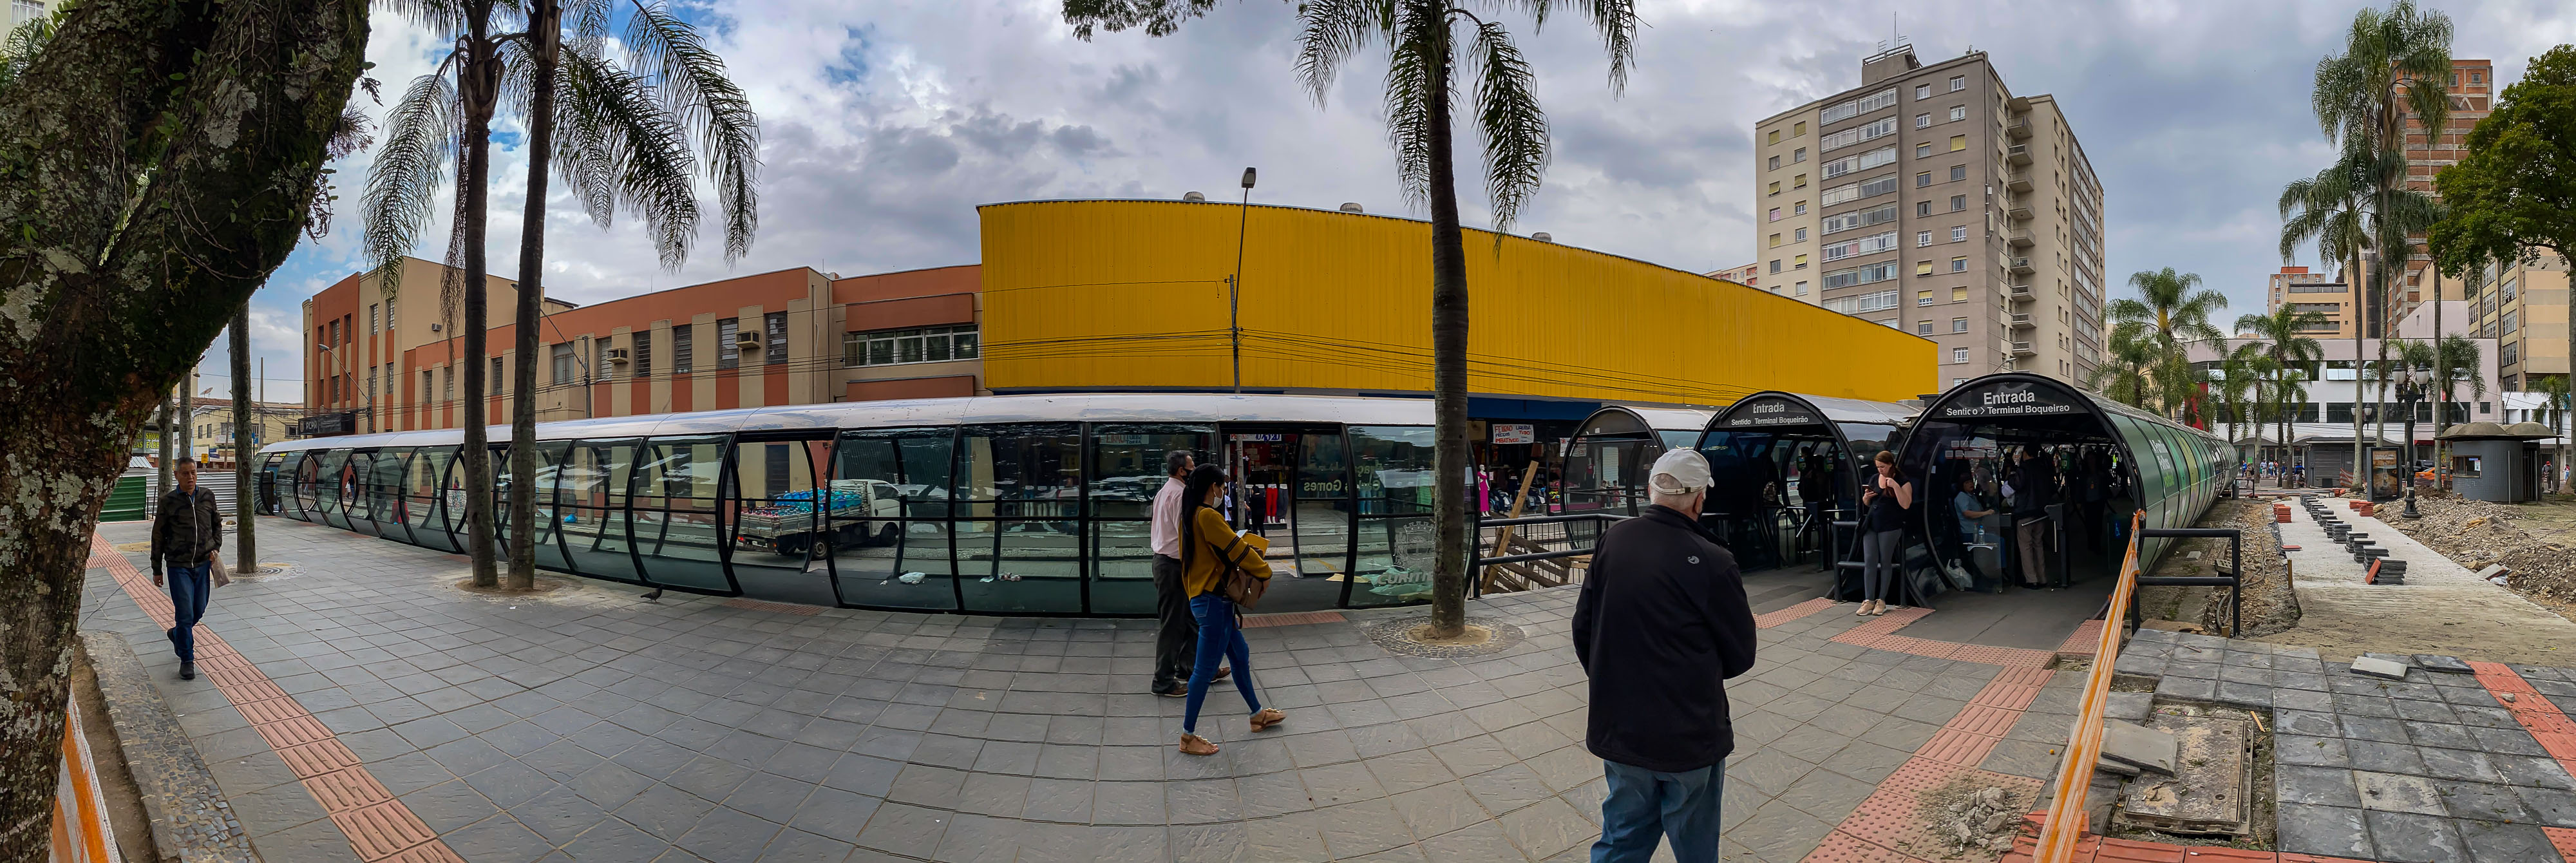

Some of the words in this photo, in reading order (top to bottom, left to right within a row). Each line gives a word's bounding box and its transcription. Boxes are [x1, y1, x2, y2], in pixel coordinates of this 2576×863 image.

[1984, 390, 2035, 404] Entrada
[1753, 403, 1785, 413] Entrada
[1987, 406, 2023, 414] Terminal
[1779, 416, 1808, 424] Boqueirão
